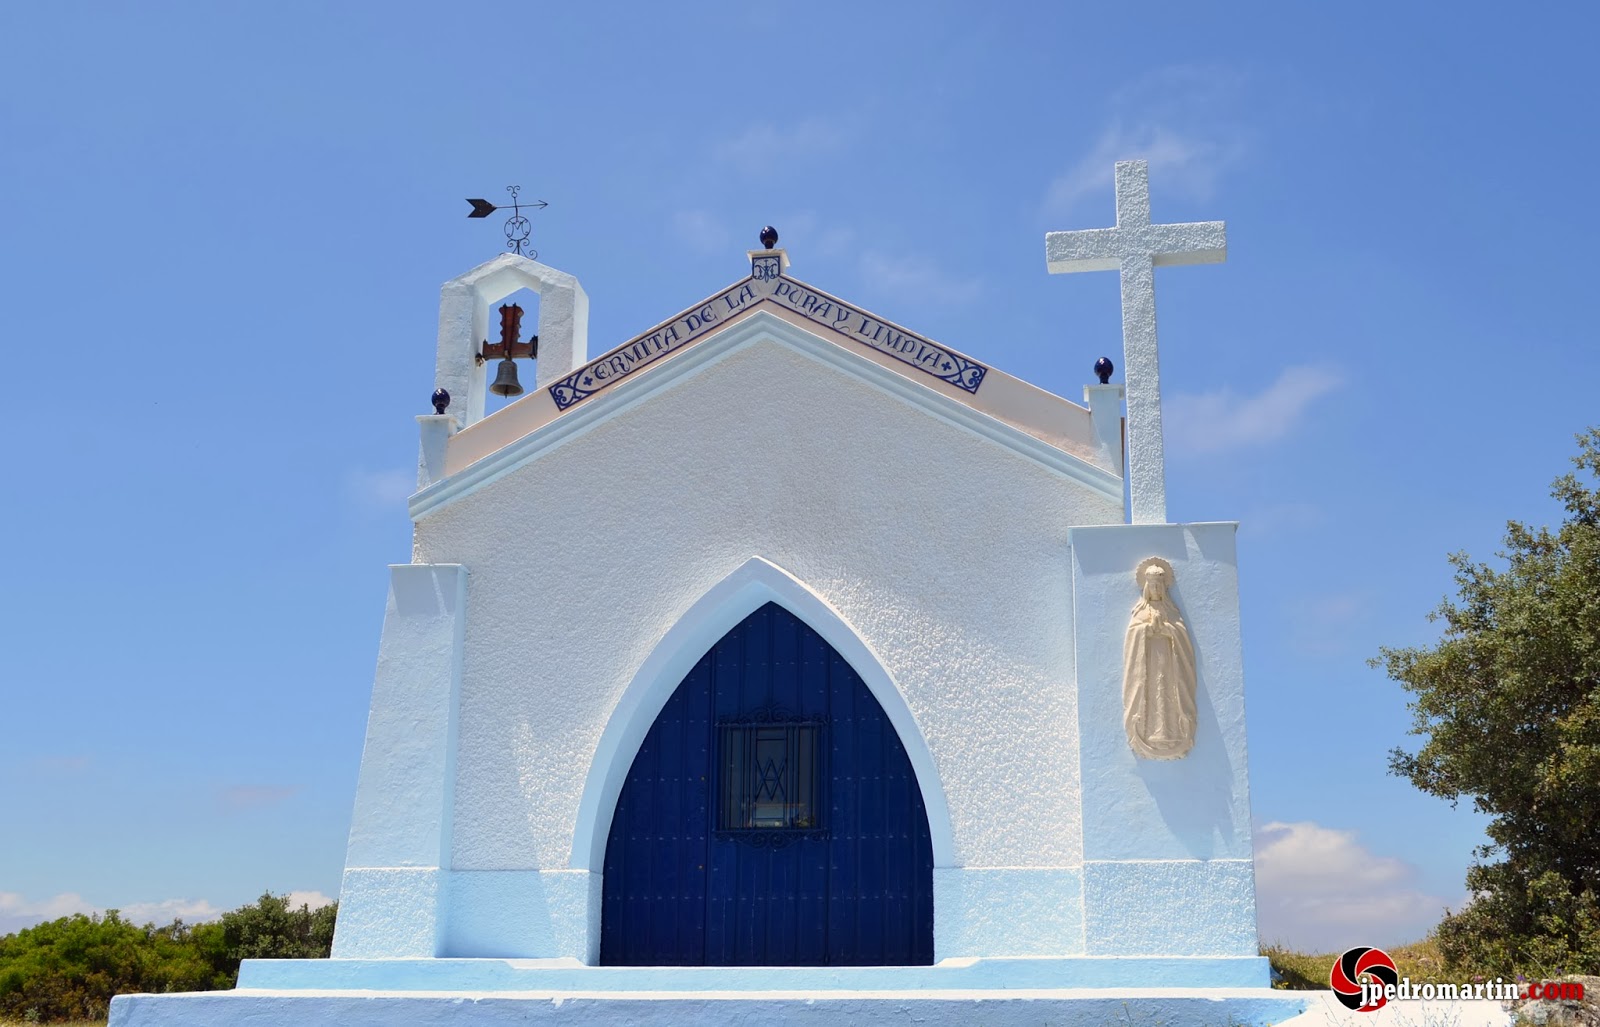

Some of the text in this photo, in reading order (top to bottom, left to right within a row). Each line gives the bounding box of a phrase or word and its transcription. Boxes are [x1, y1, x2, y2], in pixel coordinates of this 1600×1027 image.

[591, 284, 757, 380] ERMITA DE LA
[855, 315, 943, 368] LIMPIA
